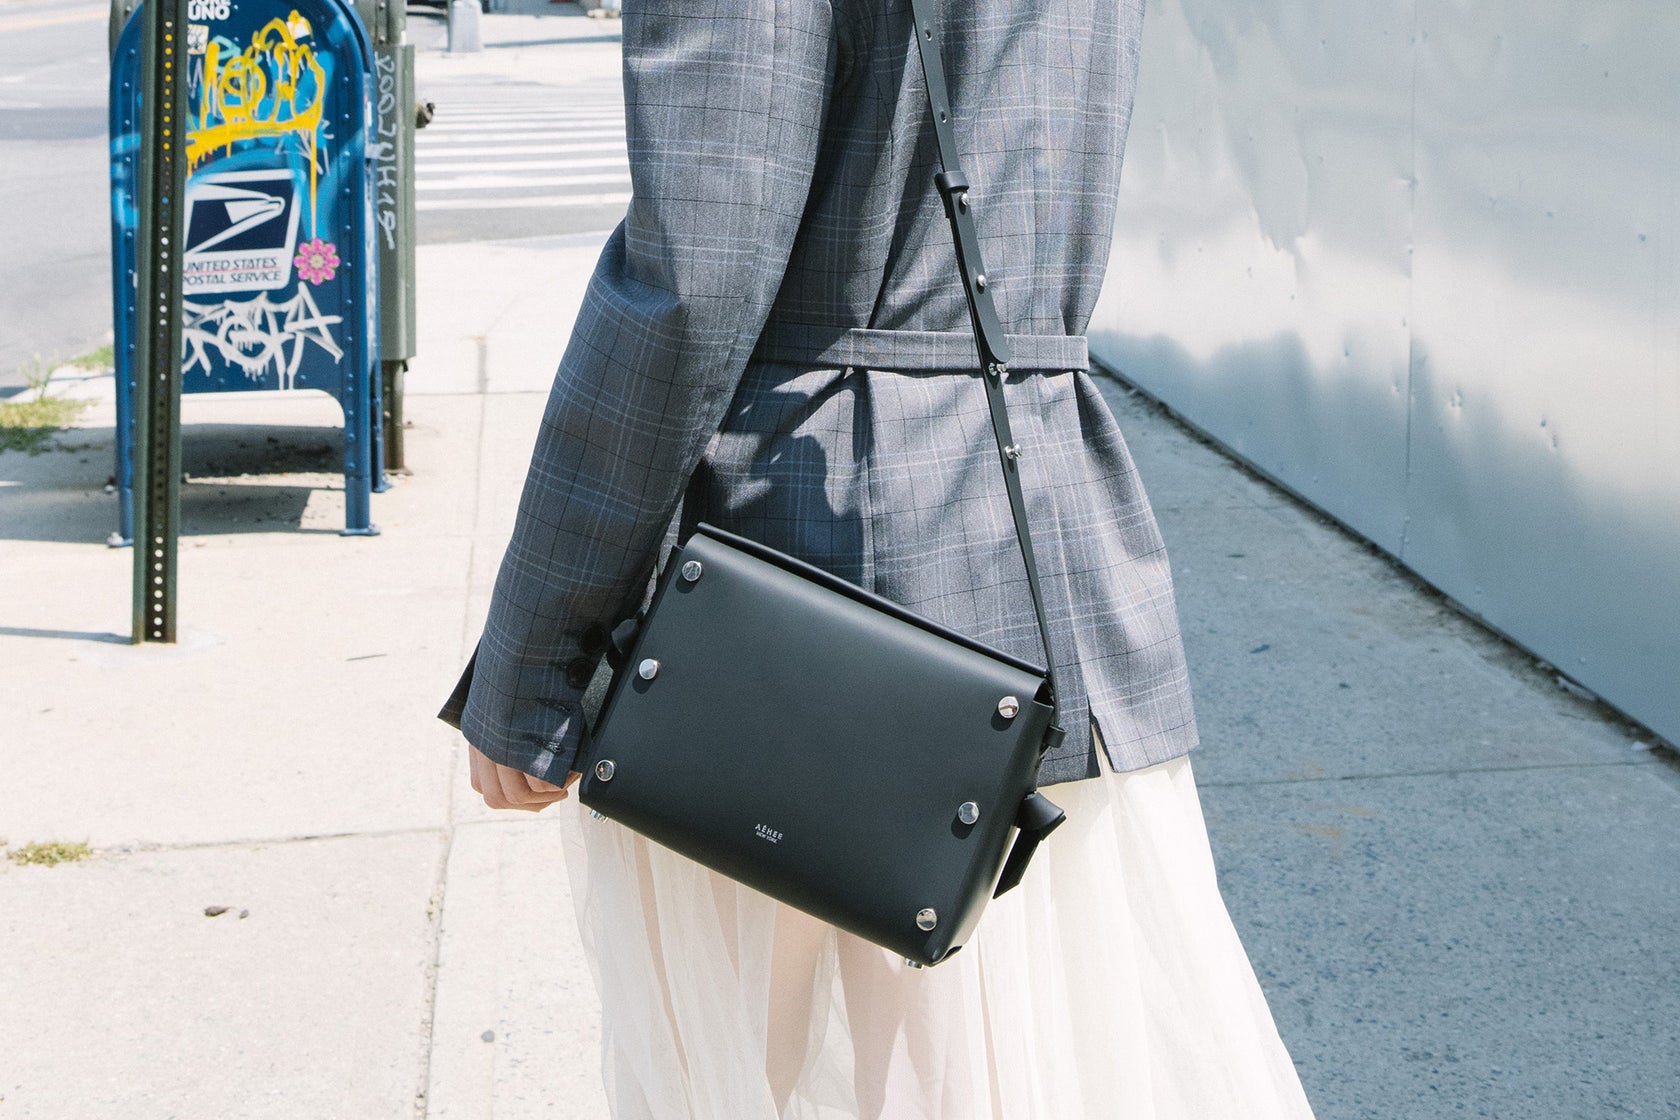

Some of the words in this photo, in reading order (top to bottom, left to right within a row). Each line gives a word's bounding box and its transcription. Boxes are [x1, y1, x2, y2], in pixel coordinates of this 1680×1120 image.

[188, 1, 230, 21] UNO
[234, 257, 277, 270] STATES
[230, 271, 281, 283] SERVICE
